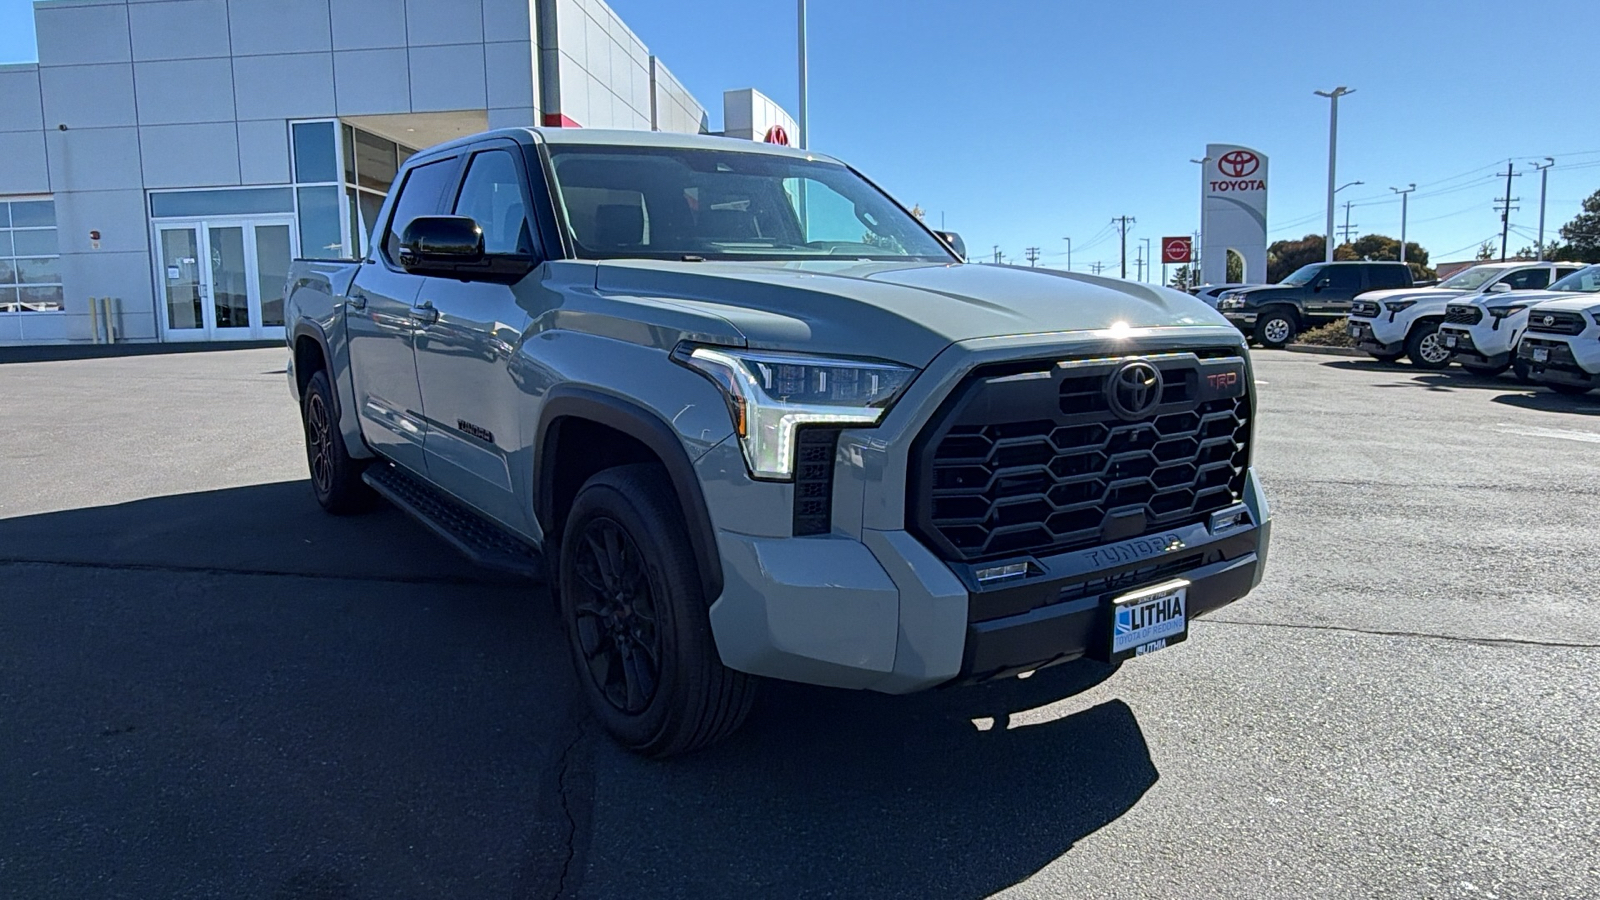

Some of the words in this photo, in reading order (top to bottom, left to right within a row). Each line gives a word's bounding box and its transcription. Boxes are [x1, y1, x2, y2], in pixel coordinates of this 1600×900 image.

[1209, 180, 1266, 192] TOYOTA
[1207, 372, 1237, 390] TRD
[1083, 533, 1186, 567] TUNDRA
[1131, 596, 1183, 631] LITHIA
[1115, 632, 1140, 646] TOYOTA
[1142, 629, 1152, 638] OF
[1153, 620, 1183, 635] REDDING
